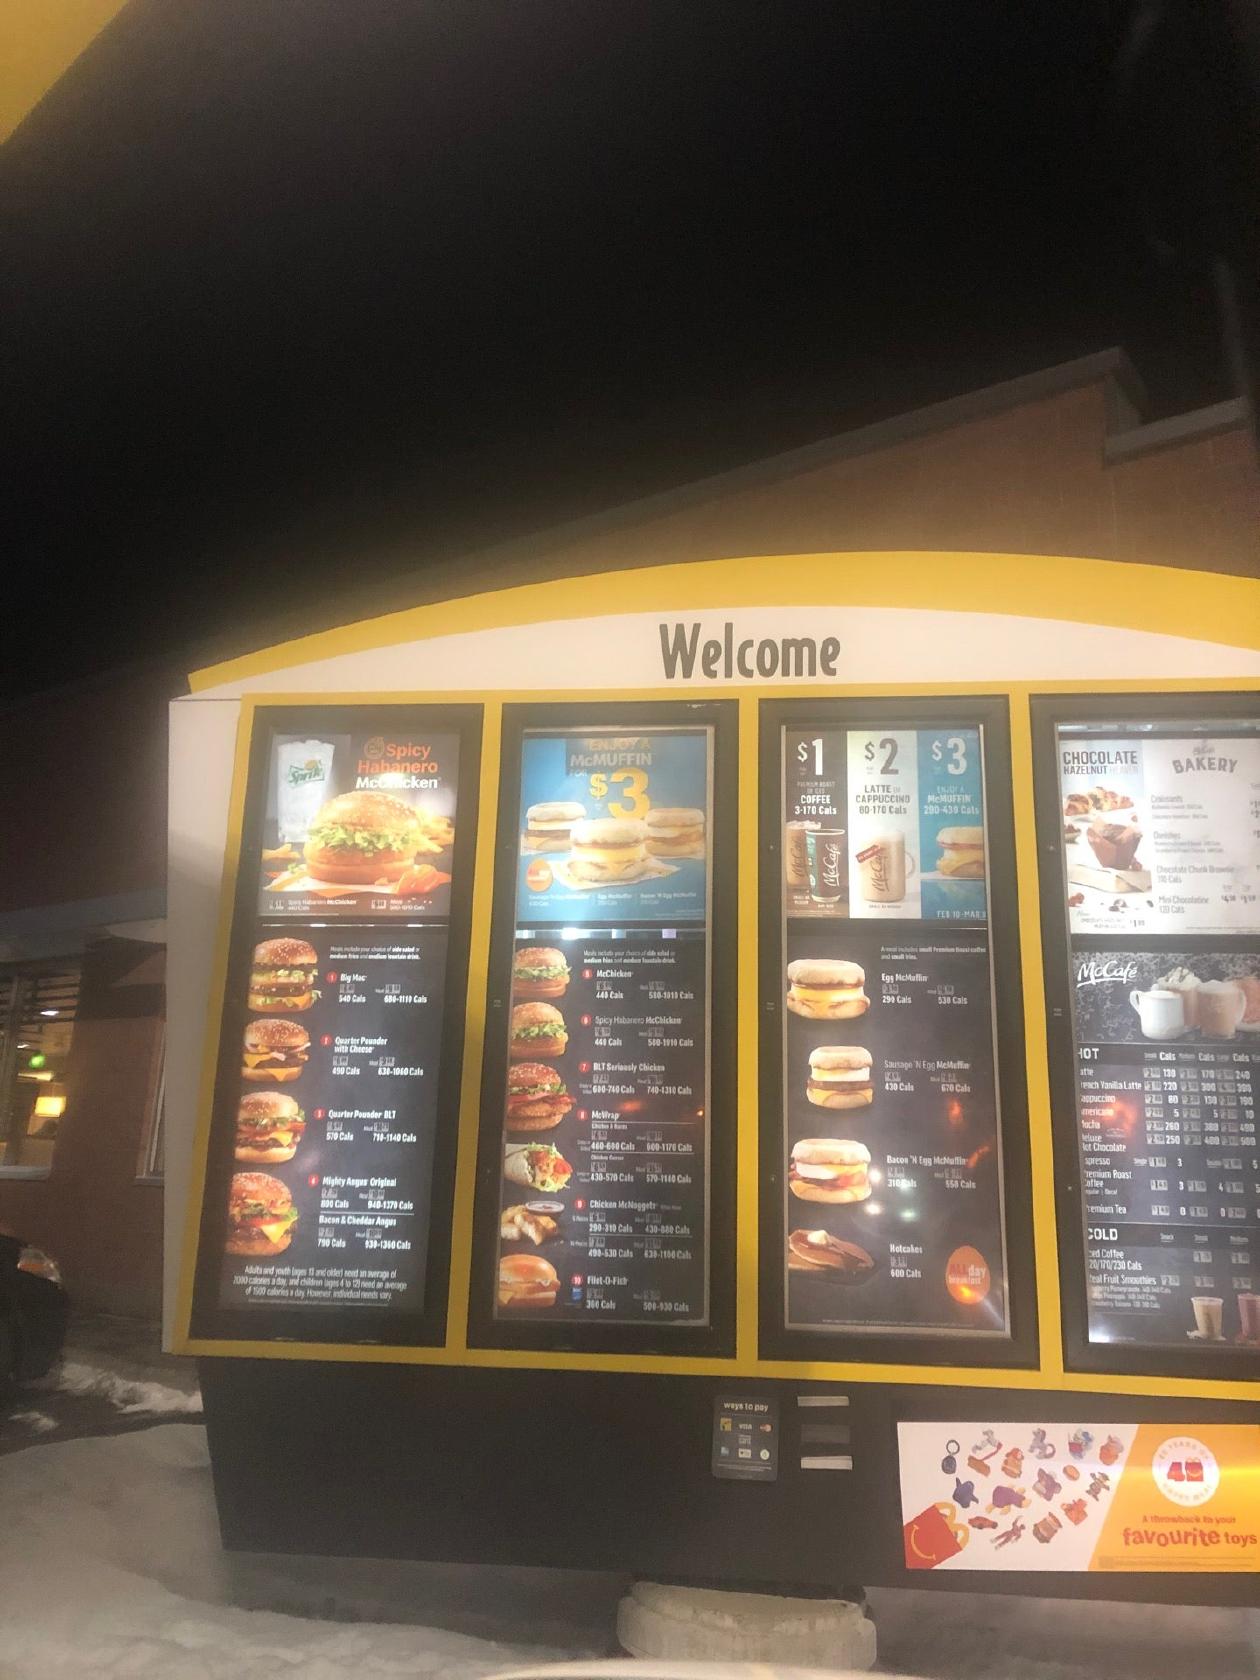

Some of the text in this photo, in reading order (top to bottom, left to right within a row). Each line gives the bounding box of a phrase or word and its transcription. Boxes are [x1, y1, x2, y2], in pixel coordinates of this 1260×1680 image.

[659, 622, 840, 679] Welcome
[386, 744, 431, 759] Spicy
[864, 737, 899, 775] $2
[931, 737, 967, 775] $3
[570, 753, 652, 766] McMUFFIN
[797, 739, 823, 775] $1
[1063, 751, 1138, 765] CHOCOLATE
[358, 760, 438, 773] Habanero
[1172, 757, 1238, 774] BAKERY
[1064, 766, 1107, 775] HAZELNUT
[356, 776, 438, 789] McChicken
[589, 767, 651, 819] $3
[865, 785, 892, 793] LATTE
[801, 795, 831, 804] COFFEE
[856, 795, 910, 803] CAPPUCCINO
[928, 795, 972, 803] McMUFFIN
[795, 806, 837, 815] 3-170 Cals
[889, 806, 907, 814] Cals
[961, 806, 979, 815] Cals
[597, 970, 632, 978] McChicken
[1077, 961, 1137, 984] McCafé
[340, 974, 351, 982] Big
[881, 973, 926, 983] Egg McMuffin
[352, 995, 366, 1003] Cals
[414, 995, 428, 1003] Cals
[680, 992, 694, 1000] Cals
[897, 996, 912, 1004] Cals
[595, 1016, 681, 1025] Spicy Habanero McChicken
[335, 1036, 388, 1046] Quarter Pounder
[608, 1038, 622, 1046] Cals
[1159, 1052, 1176, 1061] Cals
[1198, 1054, 1249, 1062] Cals Cals
[593, 1062, 665, 1073] BLT Seriously Chicken
[884, 1060, 969, 1071] Sausage Egg McMuffin
[346, 1067, 360, 1075] Cals
[409, 1068, 423, 1076] Cals
[899, 1083, 914, 1091] Cals
[955, 1084, 970, 1092] Cals
[1100, 1080, 1123, 1089] Vanilla
[1123, 1081, 1142, 1089] Latte
[678, 1087, 692, 1095] Cals
[1081, 1095, 1116, 1104] appuccino
[328, 1110, 396, 1119] Quarter Pounder BLT
[591, 1110, 620, 1121] McWrap
[339, 1132, 353, 1141] Cals
[402, 1134, 416, 1142] Cals
[621, 1142, 635, 1151] Cals
[678, 1143, 692, 1151] Cals
[1093, 1143, 1126, 1152] Chocolate
[887, 1155, 966, 1167] Bacon Egg McMuffin
[1085, 1157, 1110, 1166] spresso
[619, 1173, 634, 1182] Cals
[677, 1175, 691, 1183] Cals
[1086, 1170, 1132, 1179] remium Roast
[323, 1176, 397, 1188] Mighty Angus Original
[960, 1180, 976, 1189] Cals
[335, 1200, 349, 1208] Cals
[399, 1201, 413, 1210] Cals
[590, 1201, 617, 1209] Chicken
[618, 1201, 656, 1211] McNuggets
[1087, 1205, 1126, 1214] remium Tea
[319, 1216, 339, 1224] Bacon
[347, 1216, 375, 1225] Cheddar
[376, 1216, 396, 1228] Angus
[618, 1224, 633, 1233] Cals
[675, 1226, 690, 1234] Cals
[332, 1239, 345, 1248] Cals
[397, 1241, 411, 1250] Cals
[890, 1244, 923, 1254] Hotcakes
[619, 1250, 633, 1258] Cals
[677, 1251, 691, 1259] Cals
[1101, 1249, 1124, 1259] Coffee
[1127, 1261, 1142, 1271] Cals
[906, 1269, 921, 1278] Cals
[968, 1264, 986, 1278] day
[587, 1276, 628, 1285] Filet-O-Fish
[1103, 1275, 1156, 1285] Fruit Smoothies
[601, 1301, 616, 1309] Cals
[674, 1303, 689, 1312] Cals
[724, 1403, 743, 1411] ways
[754, 1404, 768, 1413] pay
[1203, 1515, 1213, 1523] to
[1215, 1516, 1236, 1524] your
[1123, 1528, 1257, 1548] favourite toys
